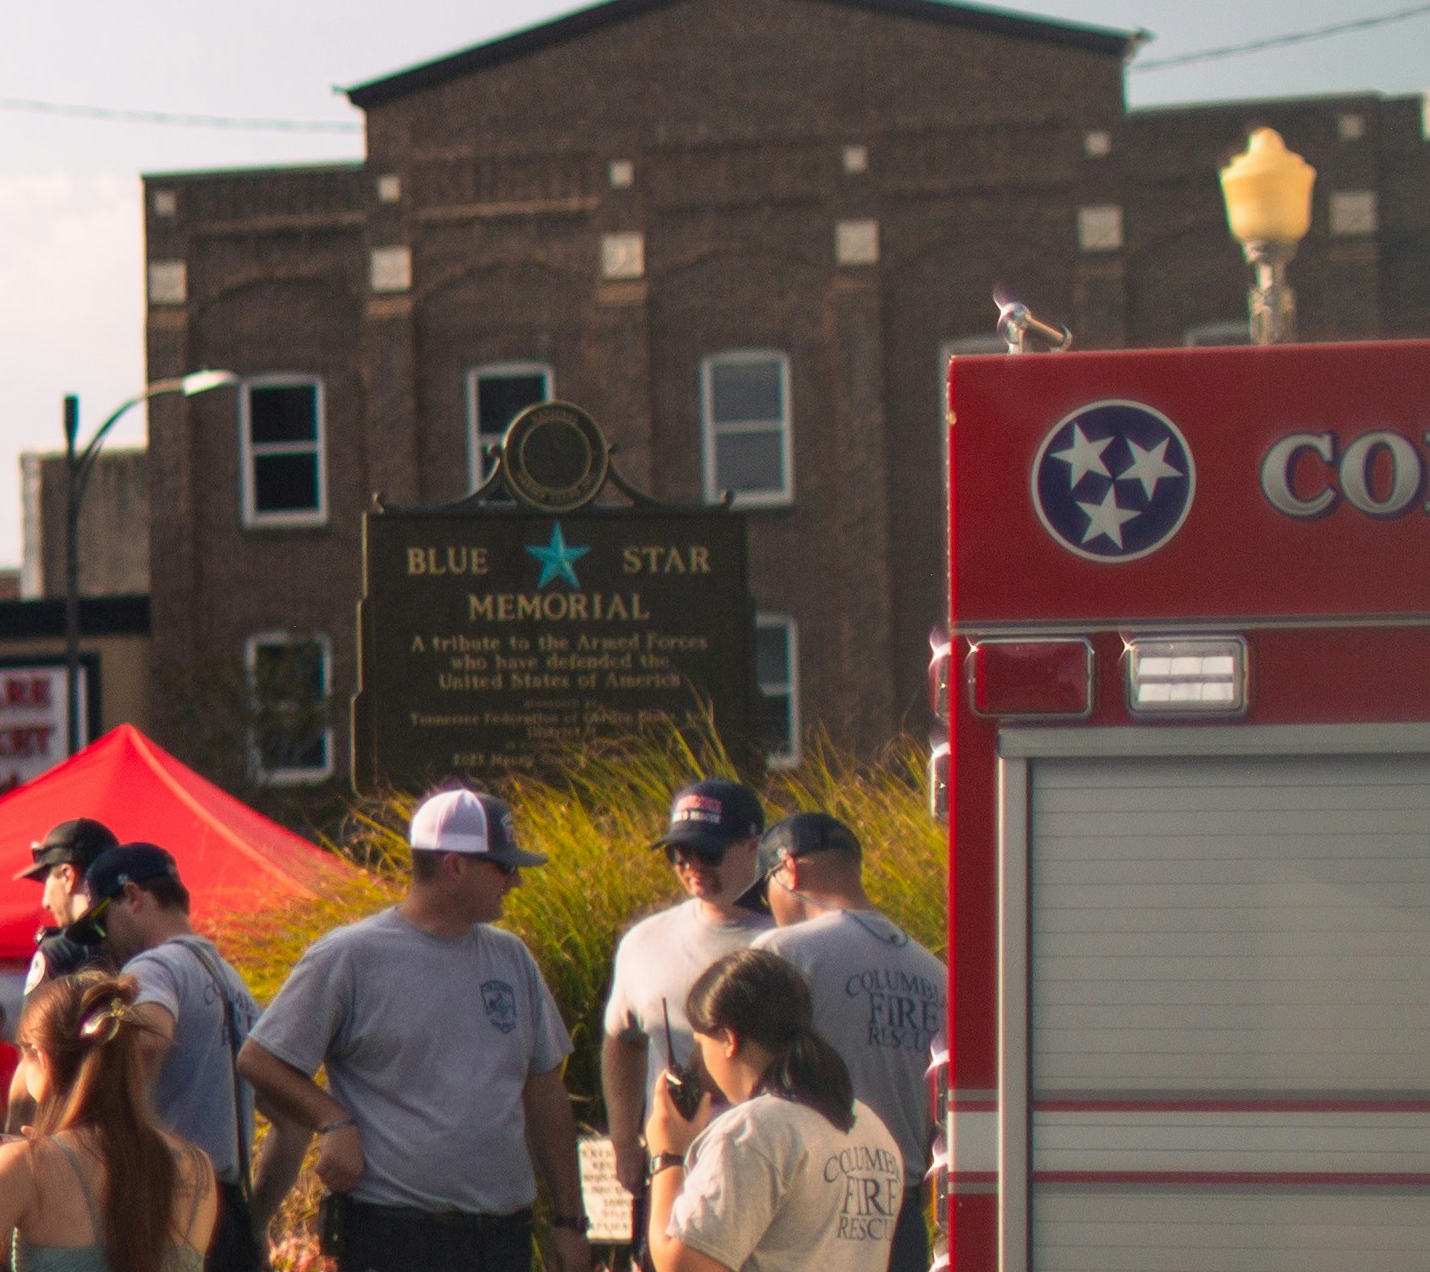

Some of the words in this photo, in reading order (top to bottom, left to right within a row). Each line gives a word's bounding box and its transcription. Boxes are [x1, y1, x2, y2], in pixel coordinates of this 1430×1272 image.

[1260, 431, 1430, 518] CO
[407, 546, 490, 576] BLUE
[622, 545, 711, 575] STAR
[468, 592, 651, 622] MEMORIAL
[412, 636, 425, 652] A
[432, 634, 501, 652] tribute
[509, 635, 530, 651] to
[539, 633, 569, 651] the
[578, 632, 641, 651] Armed
[647, 632, 708, 651] Forces
[546, 652, 632, 670] defended
[438, 672, 504, 692] United
[512, 672, 571, 691] States
[869, 992, 940, 1034] FIRE
[840, 1175, 898, 1217] FIRE
